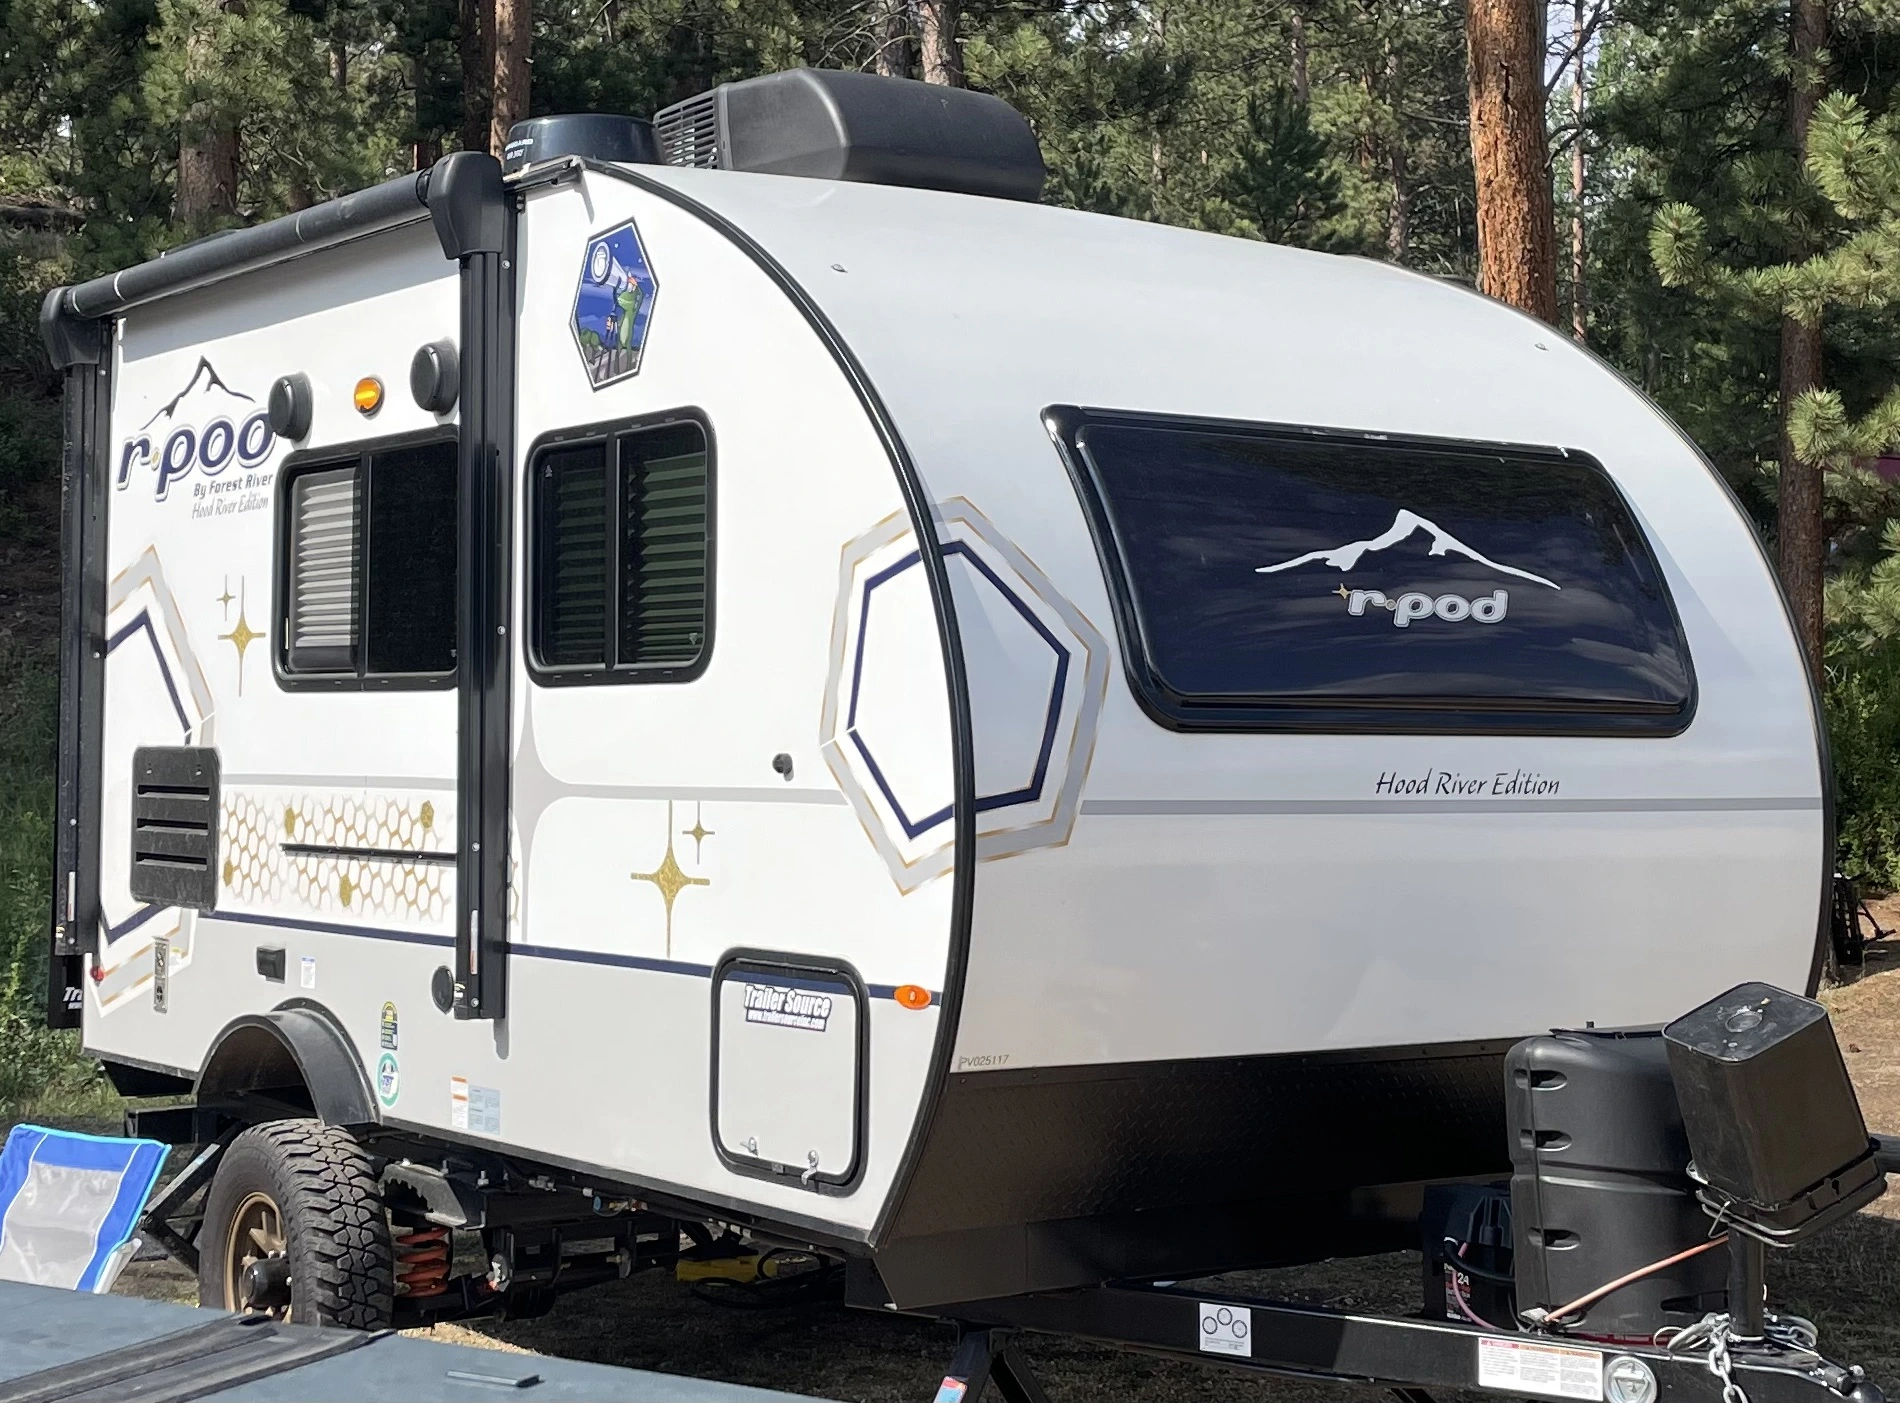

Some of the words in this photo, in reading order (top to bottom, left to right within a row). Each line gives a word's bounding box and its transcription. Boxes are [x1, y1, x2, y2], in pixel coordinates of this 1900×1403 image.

[193, 483, 207, 500] By
[208, 479, 242, 495] Forest
[245, 473, 274, 489] River
[191, 502, 215, 520] Hood
[215, 499, 236, 515] River
[237, 493, 269, 513] Edition
[1375, 767, 1434, 795] Hood
[1434, 771, 1488, 795] River
[1491, 768, 1560, 796] Edition
[744, 983, 785, 1012] Trailer
[784, 988, 832, 1019] Source
